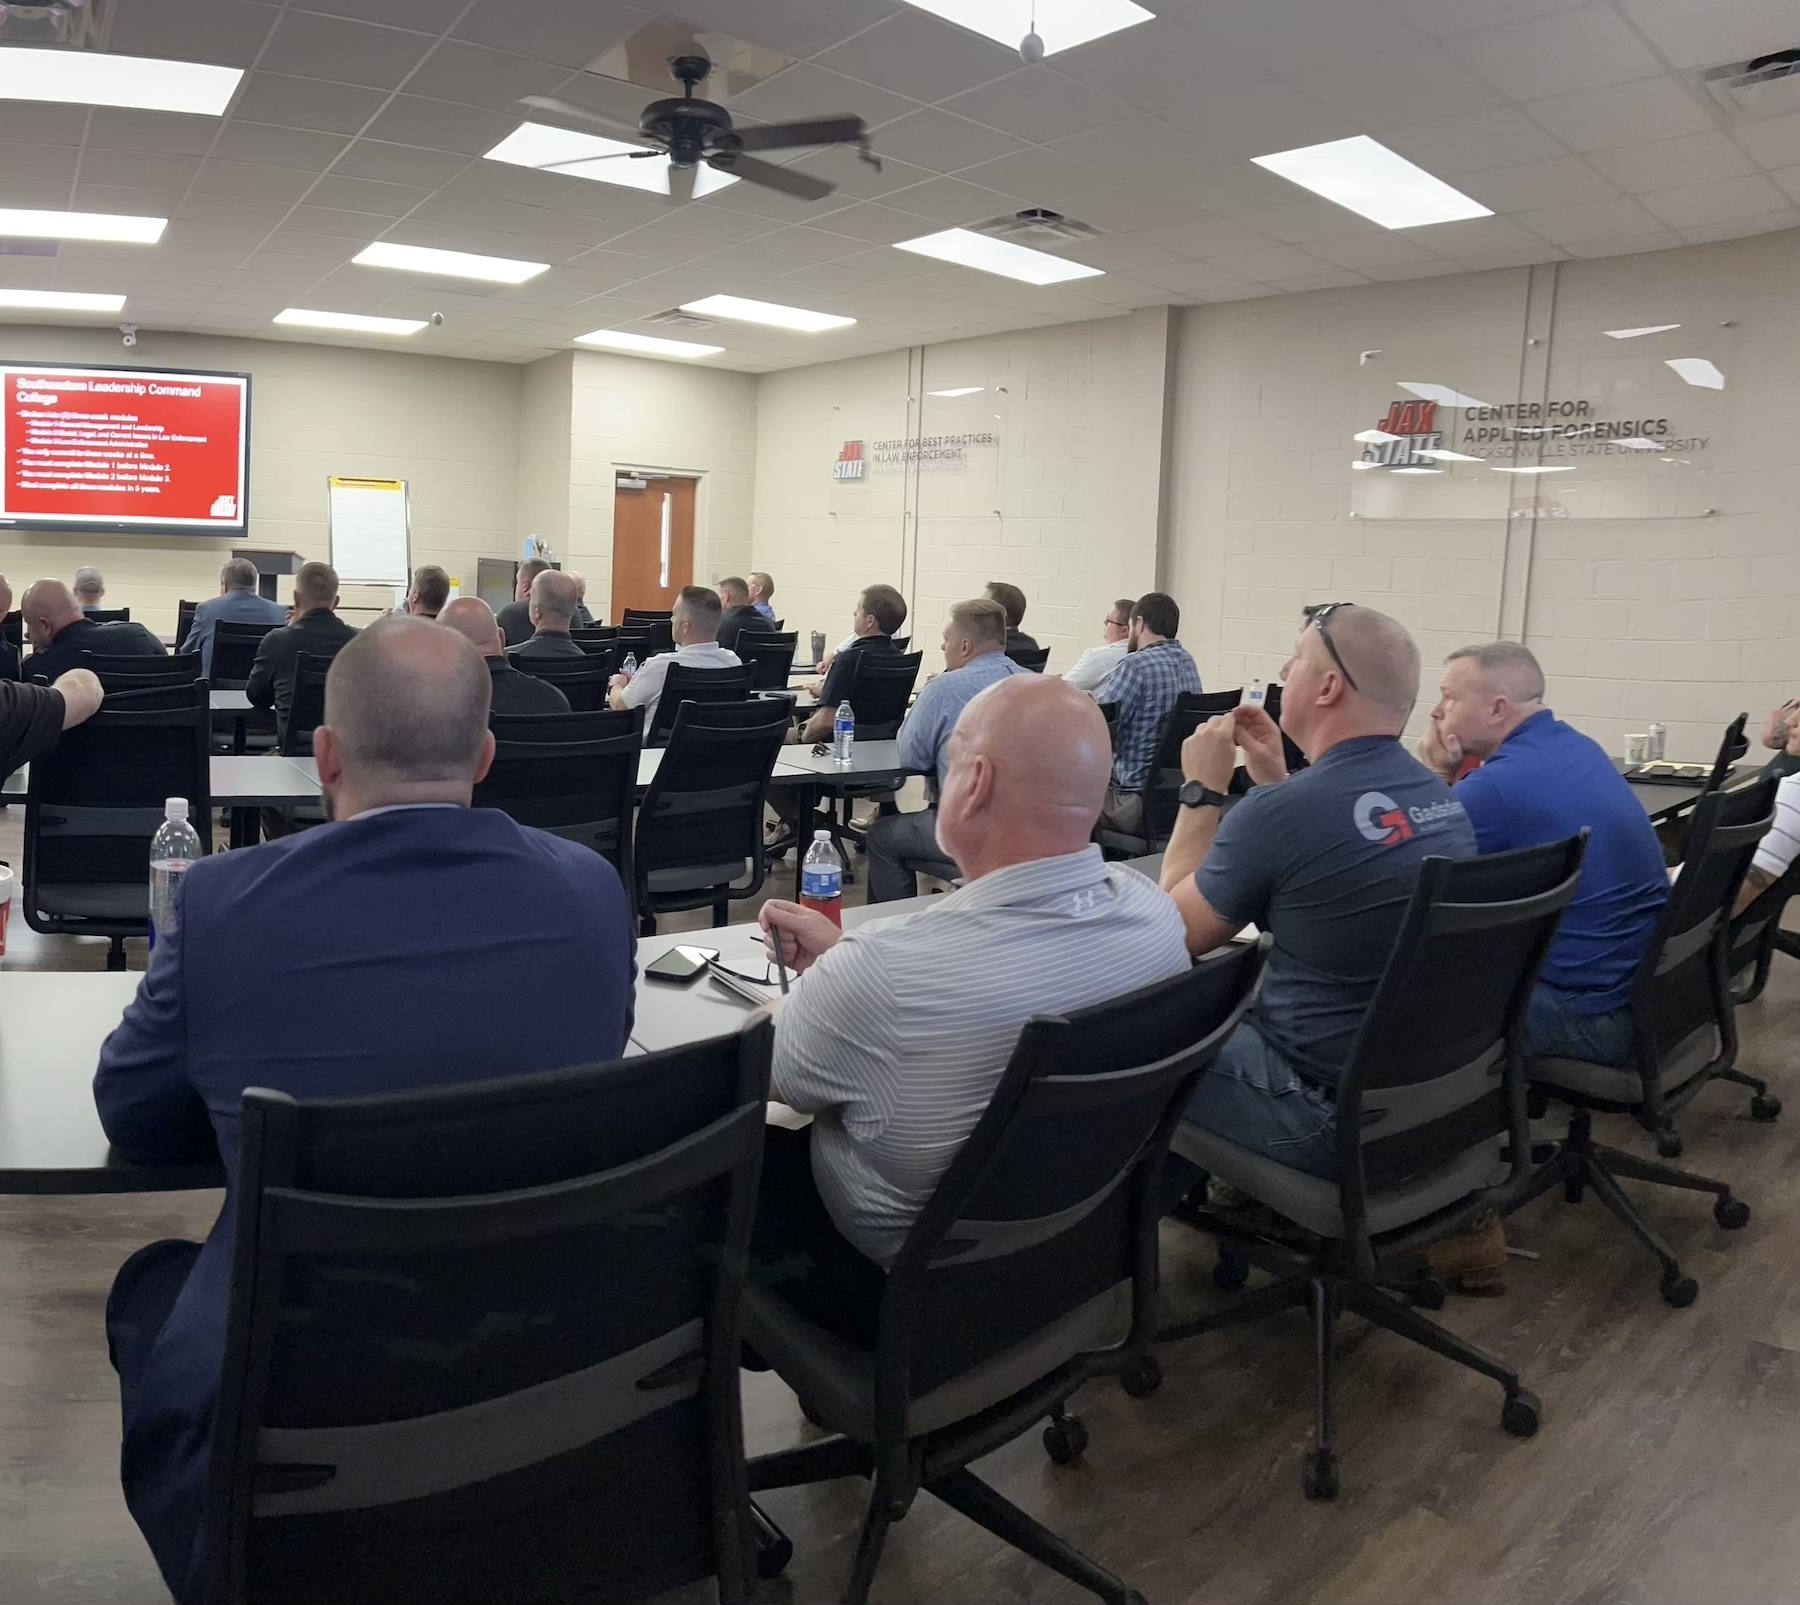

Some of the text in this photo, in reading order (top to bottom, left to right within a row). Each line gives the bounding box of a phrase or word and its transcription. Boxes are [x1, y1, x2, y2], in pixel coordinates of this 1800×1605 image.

[88, 381, 146, 396] Leadership
[148, 383, 201, 398] Command
[16, 391, 58, 405] College
[110, 414, 138, 422] modules
[1378, 400, 1440, 434] JAX
[1464, 400, 1588, 422] CENTER FOR
[133, 424, 164, 433] Leadership
[1462, 418, 1668, 444] APPLIED FORENSICS
[108, 440, 149, 448] Administration
[171, 434, 207, 443] Enforcement
[873, 433, 992, 450] CENTER FOR BEST PRACTICES
[140, 452, 155, 460] time.
[839, 440, 863, 461] JAX
[873, 449, 962, 463] IN LAW ENFORCEMENT
[1363, 431, 1443, 467] STATE
[117, 462, 138, 470] before
[139, 463, 164, 471] Module
[165, 464, 171, 472] 2.
[833, 459, 864, 479] STATE
[117, 473, 138, 481] before
[139, 474, 164, 482] Module
[165, 475, 171, 483] 3.
[127, 484, 134, 492] in
[141, 486, 161, 494] years.
